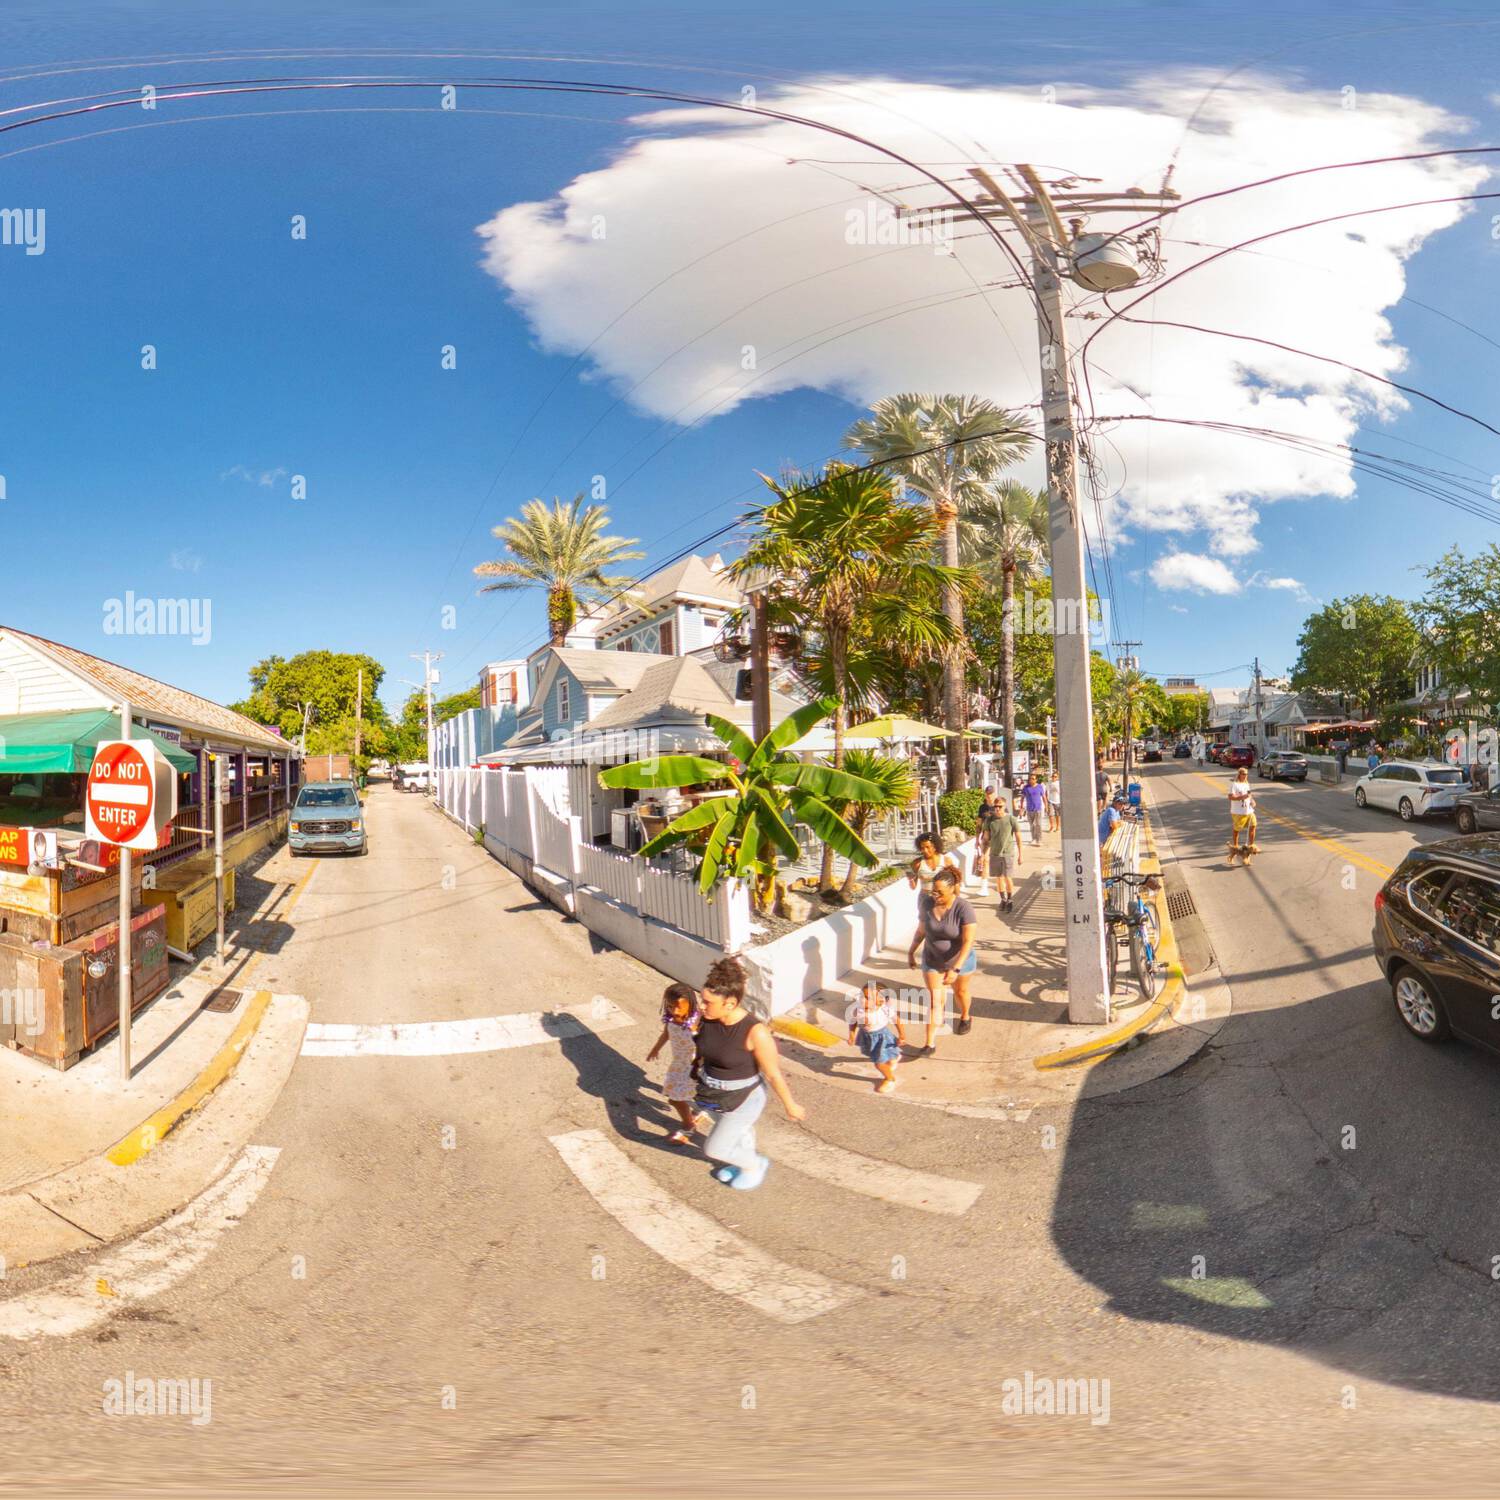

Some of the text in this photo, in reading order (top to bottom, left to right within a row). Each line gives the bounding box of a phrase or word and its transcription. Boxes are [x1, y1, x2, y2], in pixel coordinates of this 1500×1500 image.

[95, 762, 143, 780] DO NOT
[98, 806, 137, 826] ENTER
[0, 831, 18, 843] AP
[1074, 851, 1085, 900] ROSE
[1073, 914, 1090, 924] LN
